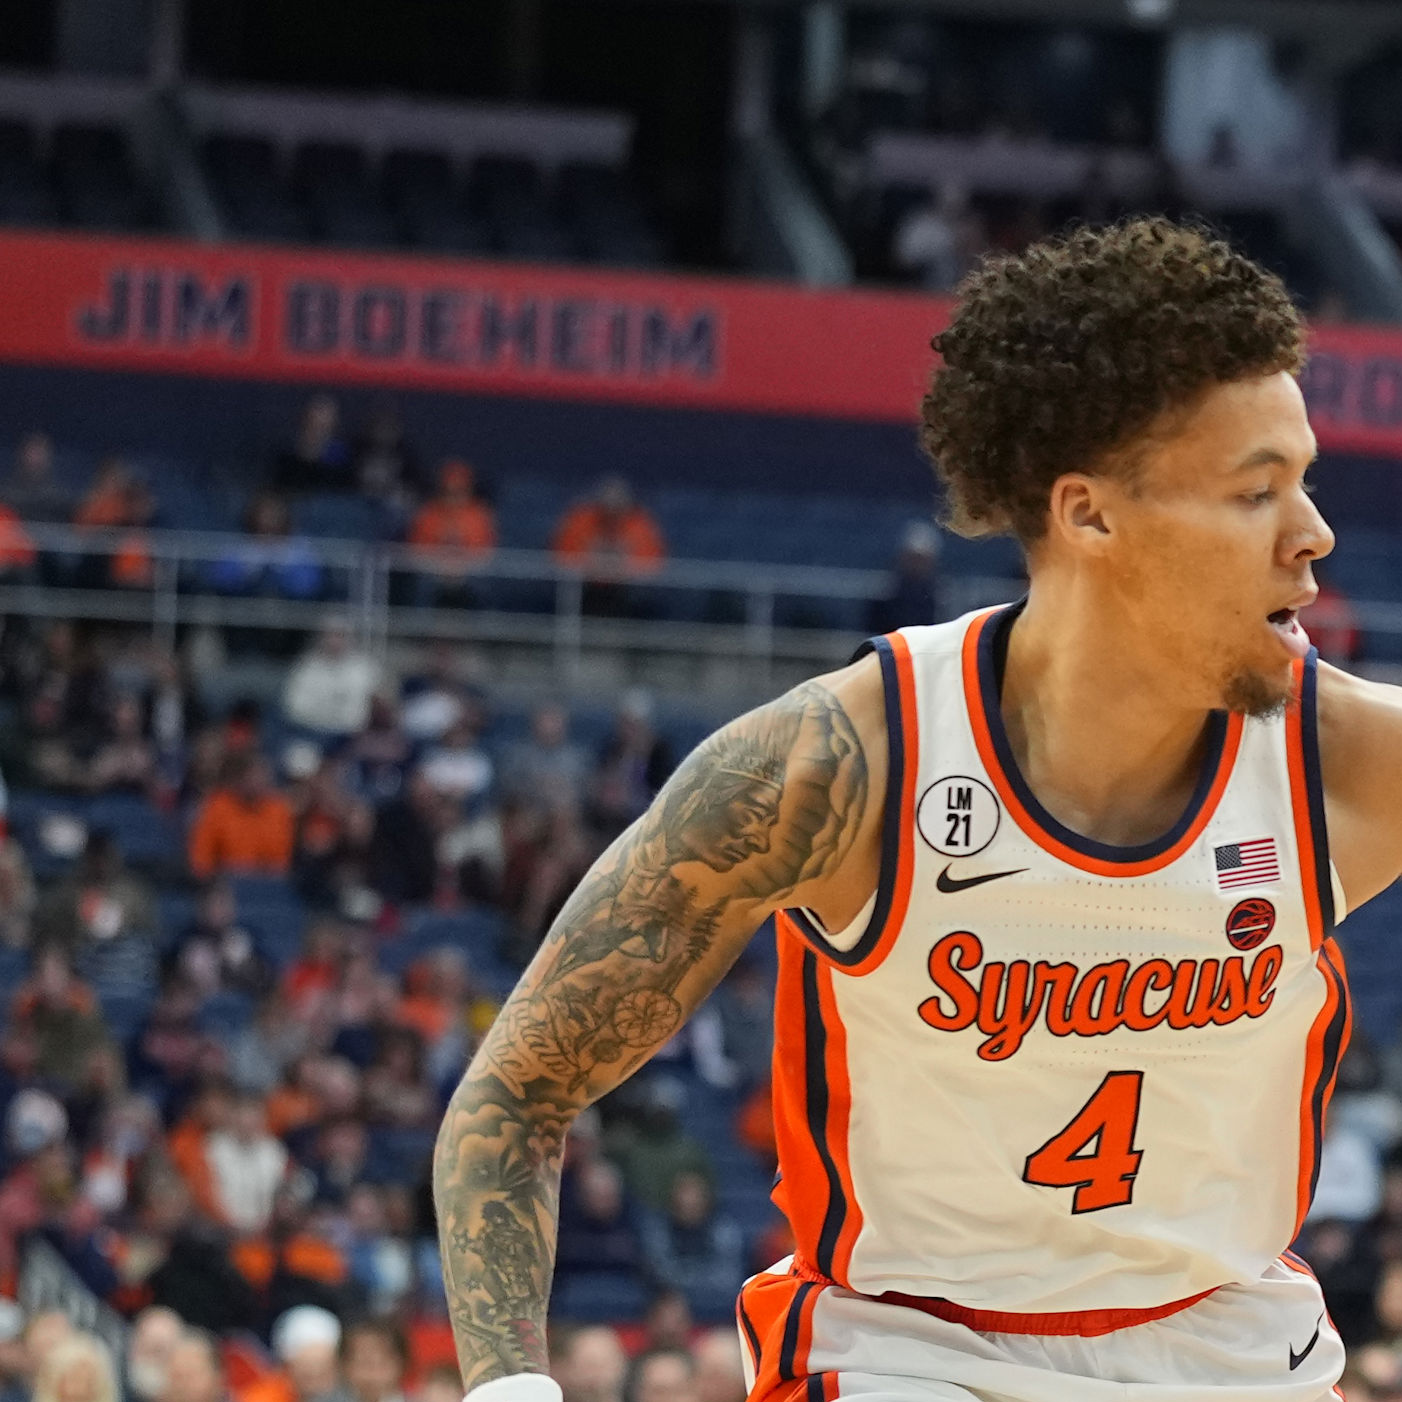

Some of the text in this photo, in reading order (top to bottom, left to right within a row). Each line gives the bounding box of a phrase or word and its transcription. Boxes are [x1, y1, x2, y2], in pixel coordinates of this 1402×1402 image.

[78, 266, 717, 380] JIM BOEHEIM
[945, 813, 972, 847] 21
[947, 786, 973, 810] LM
[917, 931, 1283, 1062] Syracuse
[1021, 1069, 1145, 1215] 4
